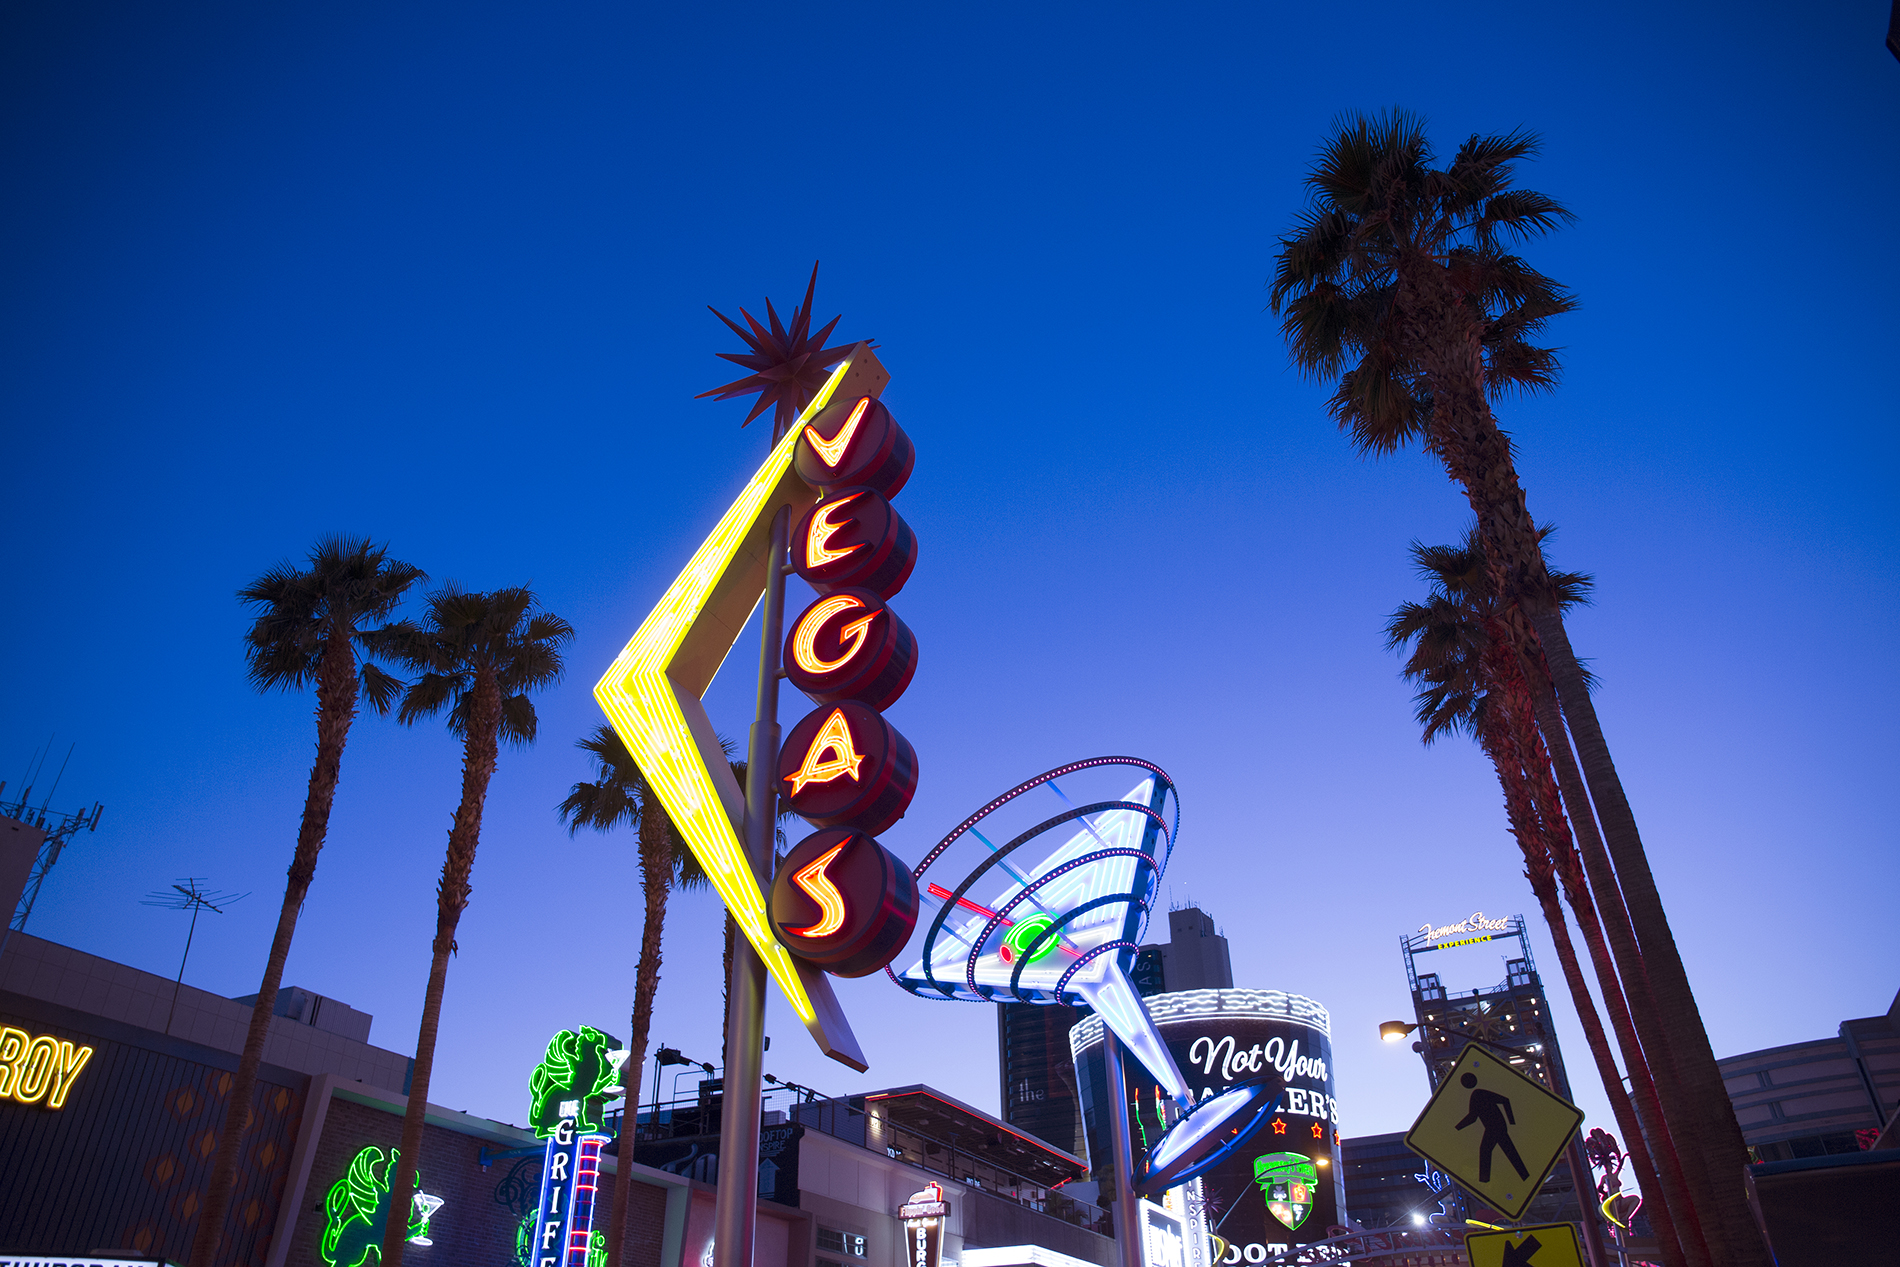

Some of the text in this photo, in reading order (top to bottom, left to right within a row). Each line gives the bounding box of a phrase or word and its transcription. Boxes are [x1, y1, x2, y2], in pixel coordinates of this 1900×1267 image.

[779, 396, 883, 939] VEGAS
[1418, 911, 1509, 948] Fremont Street
[1437, 934, 1493, 950] EXPERIENCE
[1189, 1035, 1328, 1082] Not Your
[1019, 1077, 1045, 1102] the
[759, 1127, 793, 1142] OOFTOP
[926, 1203, 945, 1214] Good
